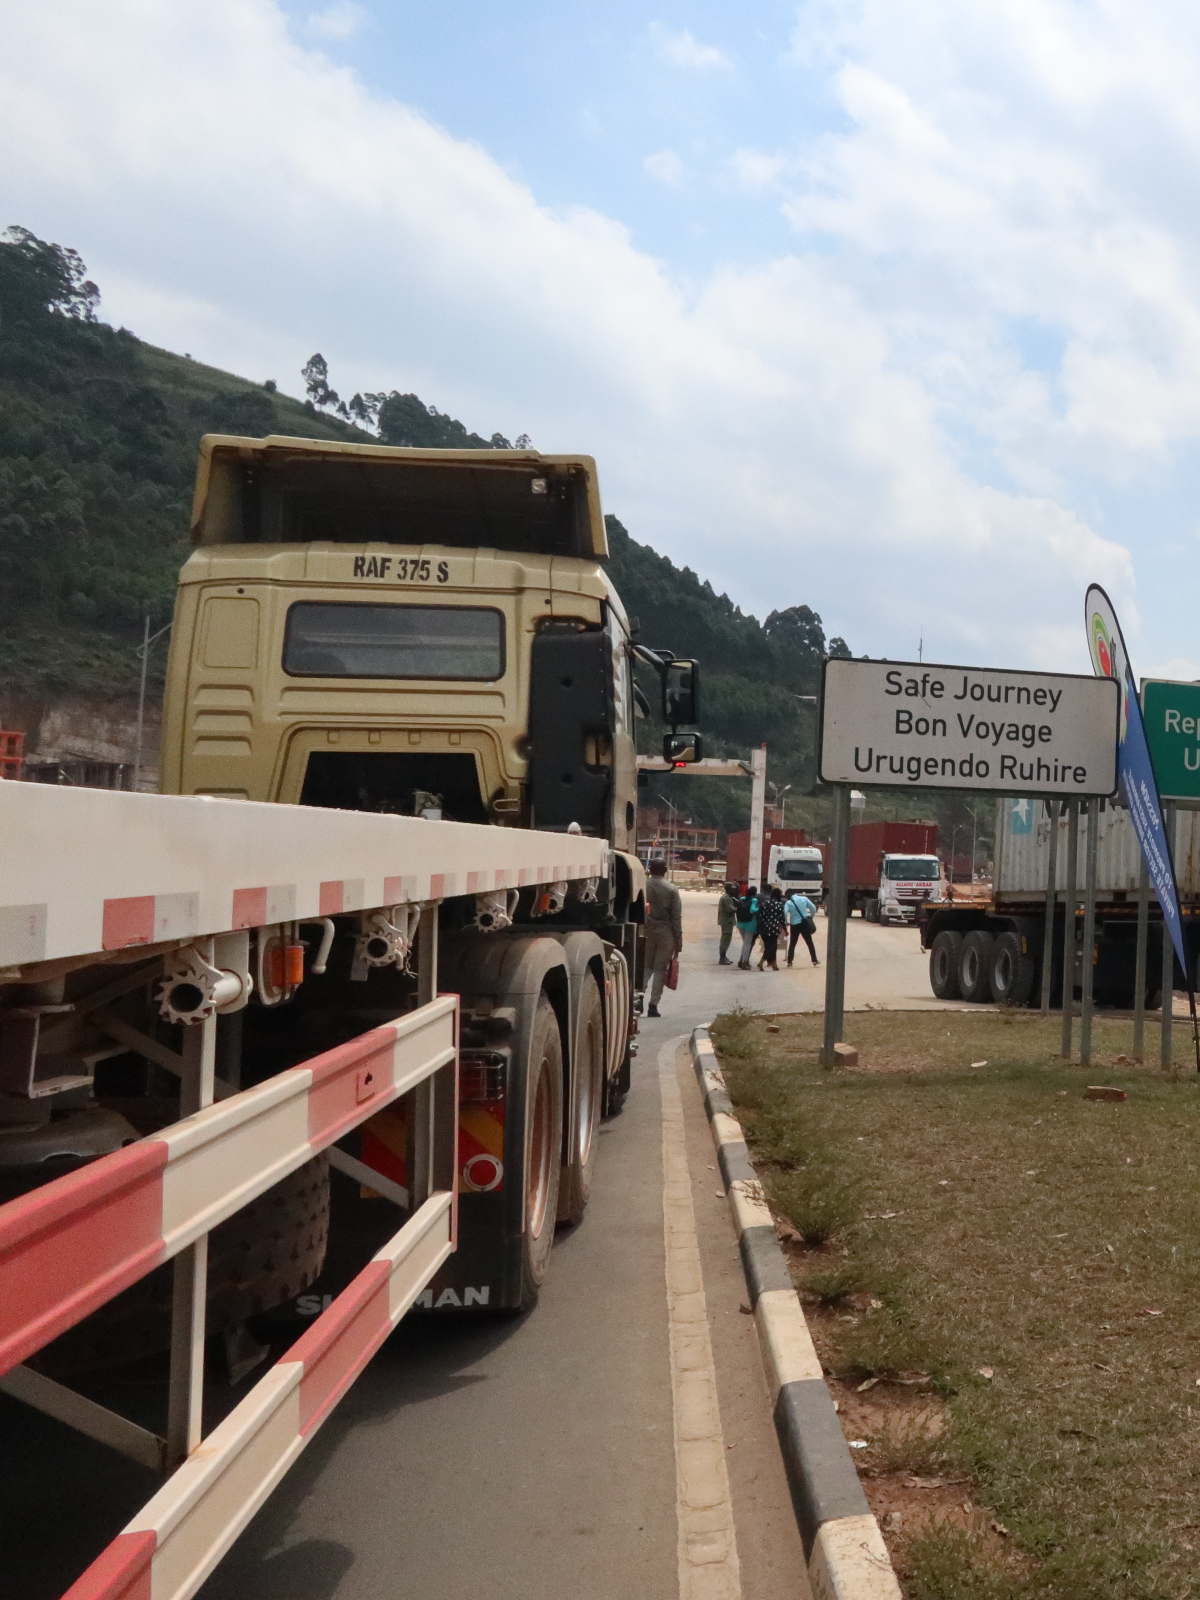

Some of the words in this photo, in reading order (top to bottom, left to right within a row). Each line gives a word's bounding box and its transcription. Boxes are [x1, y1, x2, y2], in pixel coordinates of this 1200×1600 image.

[353, 556, 392, 578] RAF
[397, 559, 431, 581] 375
[437, 561, 449, 583] S
[884, 670, 945, 698] Safe
[953, 676, 1063, 713] Journey
[895, 709, 947, 737] Bon
[956, 713, 1053, 749] Voyage
[853, 747, 990, 781] Urugendo
[1000, 755, 1088, 784] Ruhire
